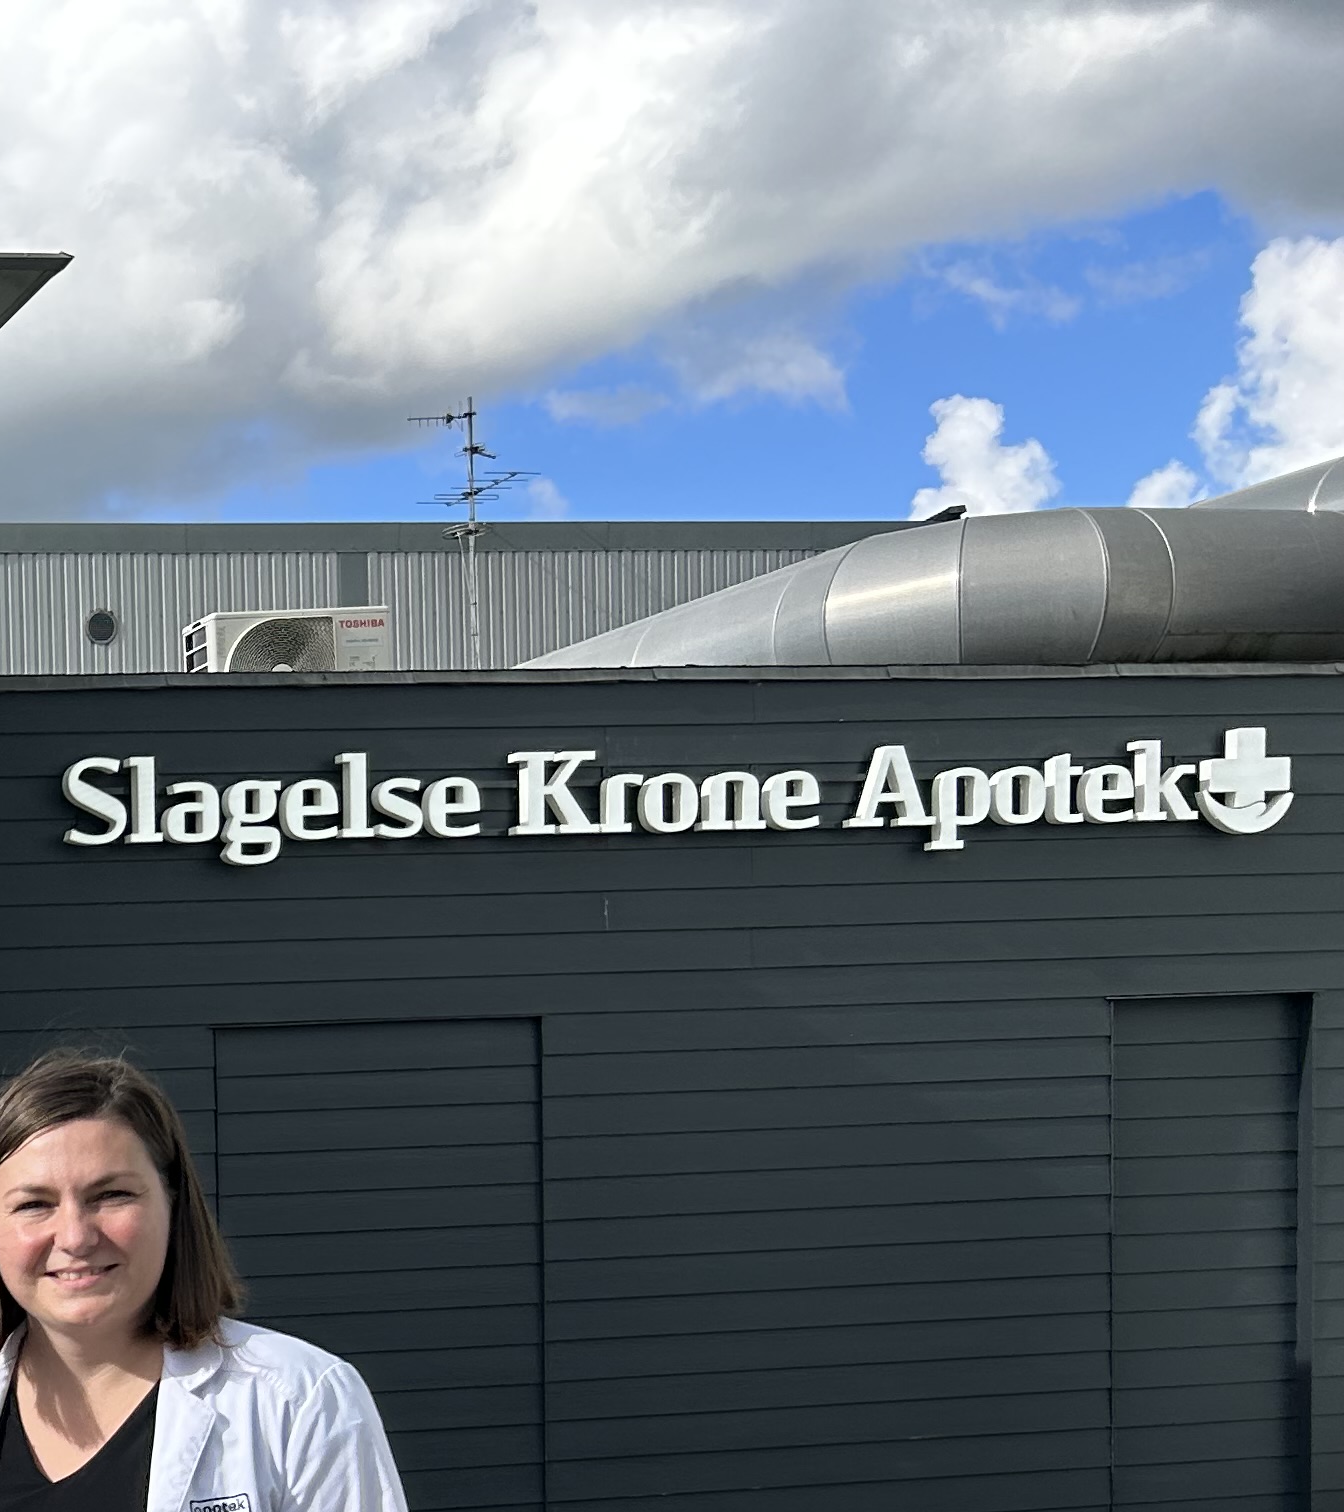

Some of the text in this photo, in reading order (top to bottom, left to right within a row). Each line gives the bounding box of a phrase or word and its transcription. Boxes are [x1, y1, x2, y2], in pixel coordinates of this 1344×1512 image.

[338, 618, 385, 629] TOSHIBA
[62, 739, 1199, 866] Slagelse Krone Apotek
